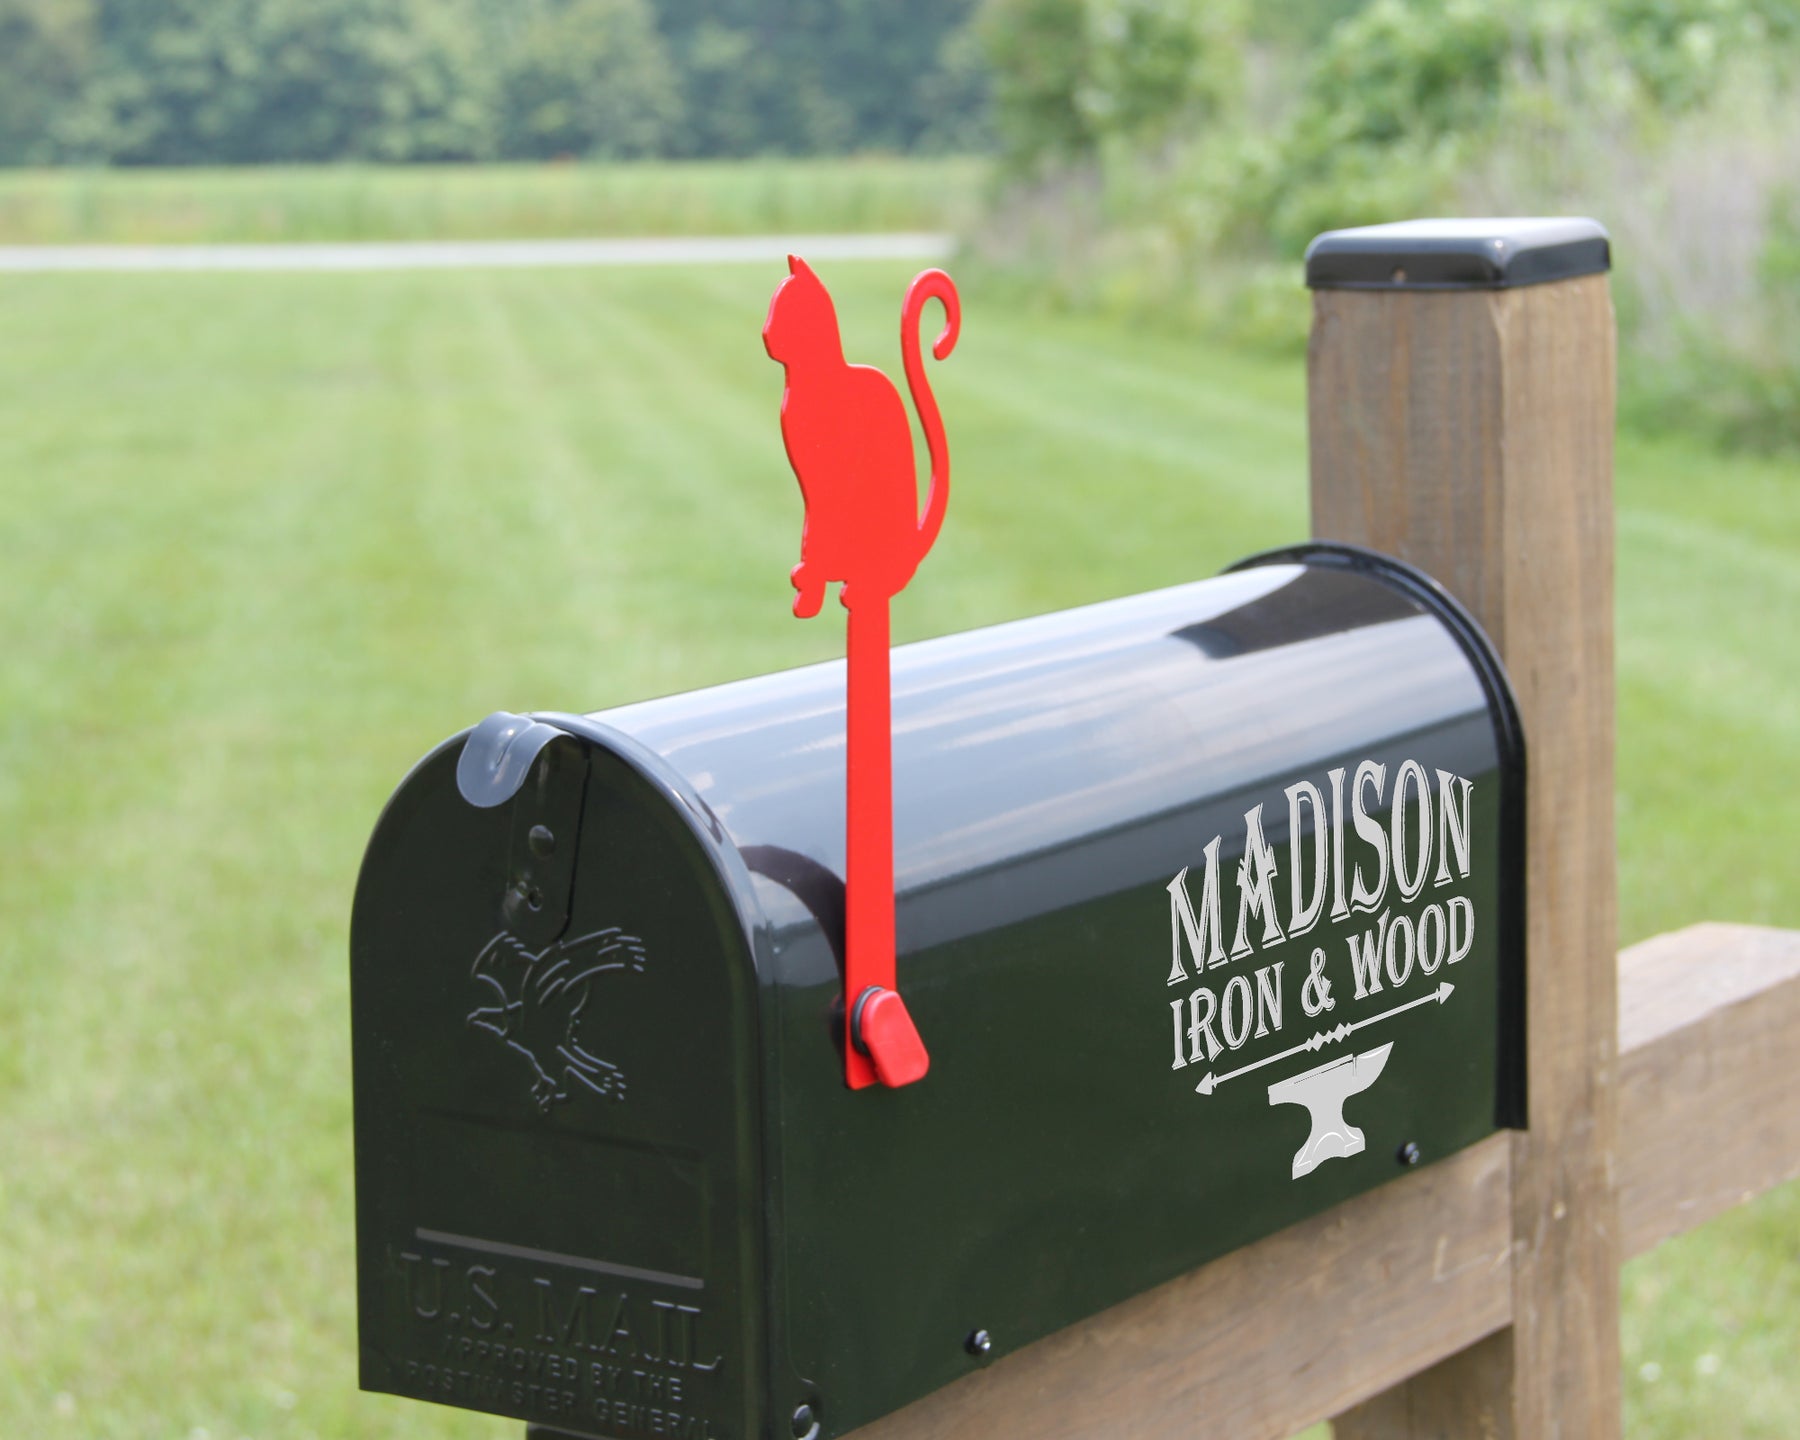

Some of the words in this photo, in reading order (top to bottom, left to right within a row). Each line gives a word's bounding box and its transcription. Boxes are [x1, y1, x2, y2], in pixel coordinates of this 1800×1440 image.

[400, 1251, 514, 1333] U.S.
[533, 1277, 724, 1373] MAIL
[441, 1334, 579, 1381] APPROVED
[588, 1361, 624, 1391] BY
[631, 1368, 684, 1402] THE
